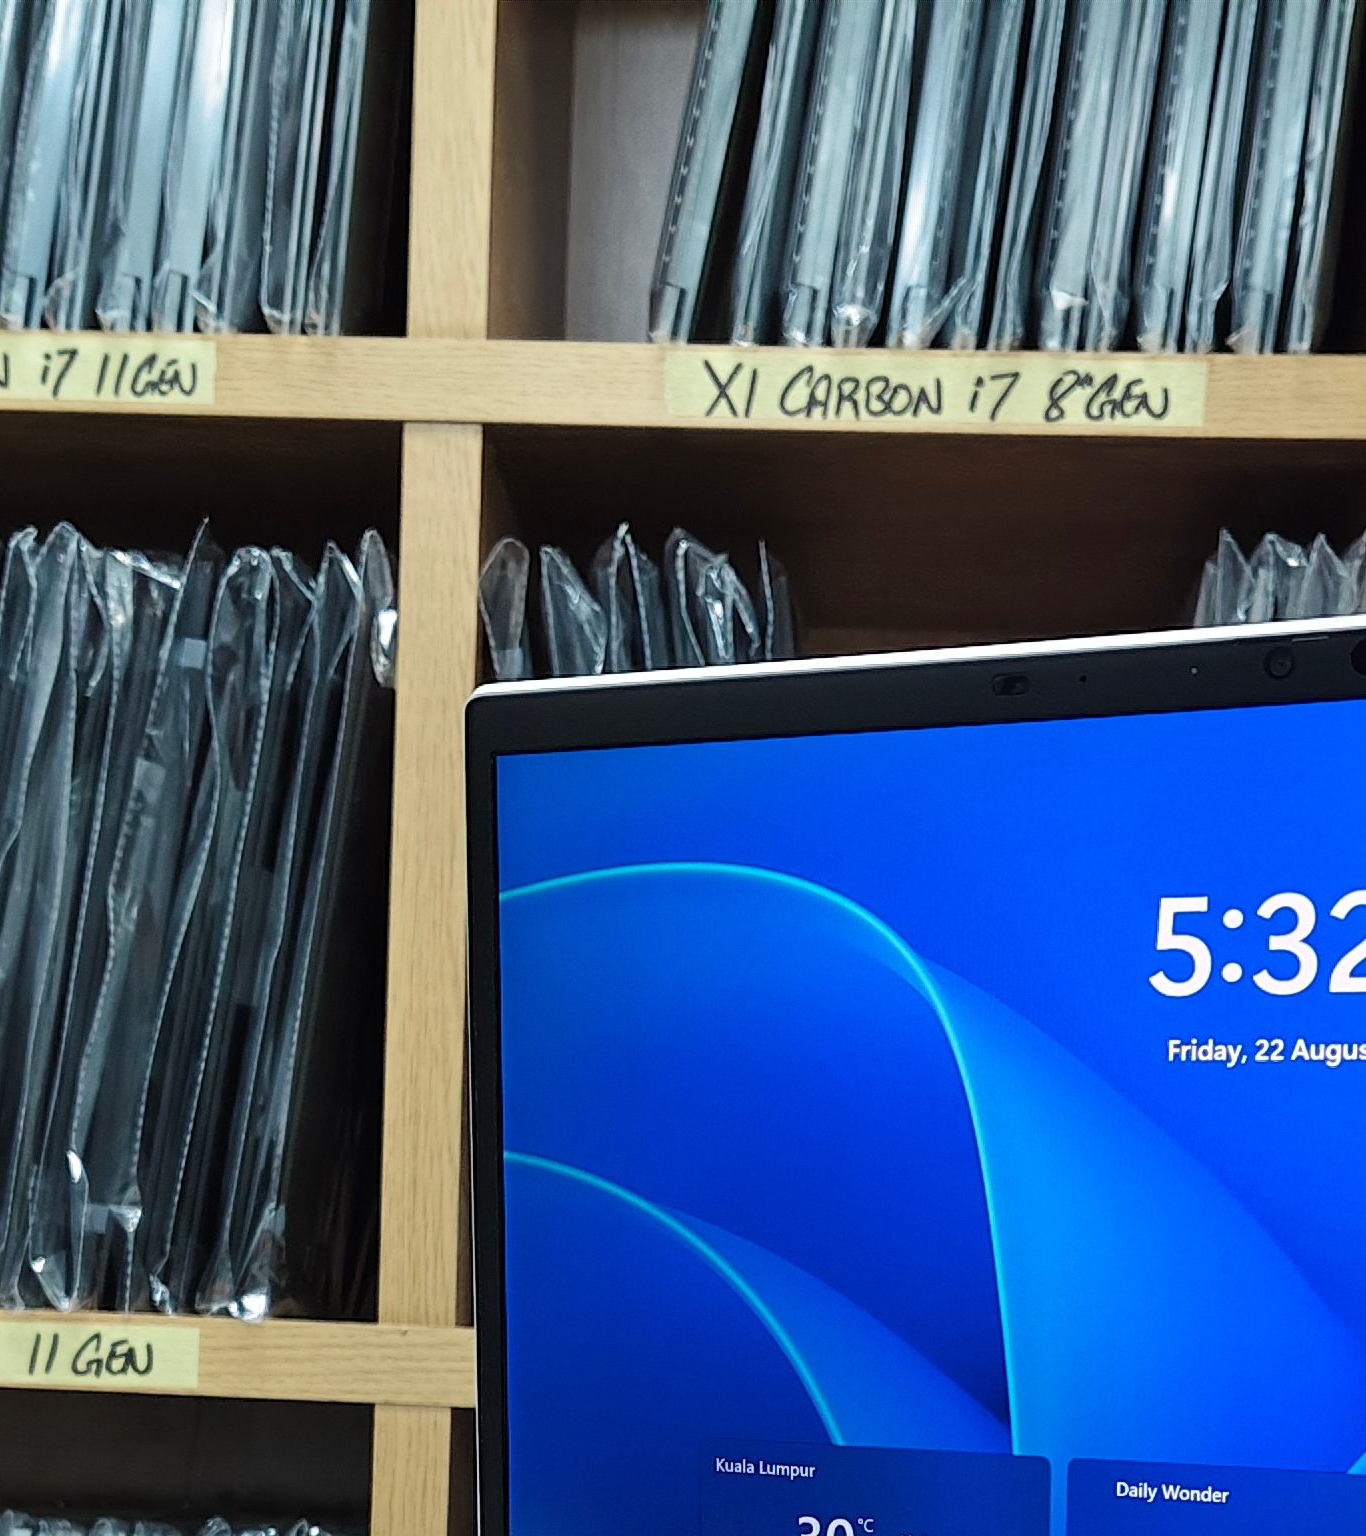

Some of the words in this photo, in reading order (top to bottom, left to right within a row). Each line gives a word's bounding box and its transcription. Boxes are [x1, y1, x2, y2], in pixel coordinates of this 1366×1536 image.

[780, 365, 942, 421] CARBON
[1167, 1038, 1247, 1068] Friday,
[1255, 1039, 1284, 1061] 22
[715, 1457, 755, 1474] Kuala
[759, 1460, 816, 1481] Lumpur
[1116, 1481, 1157, 1502] Daily
[1161, 1485, 1230, 1503] Wonder
